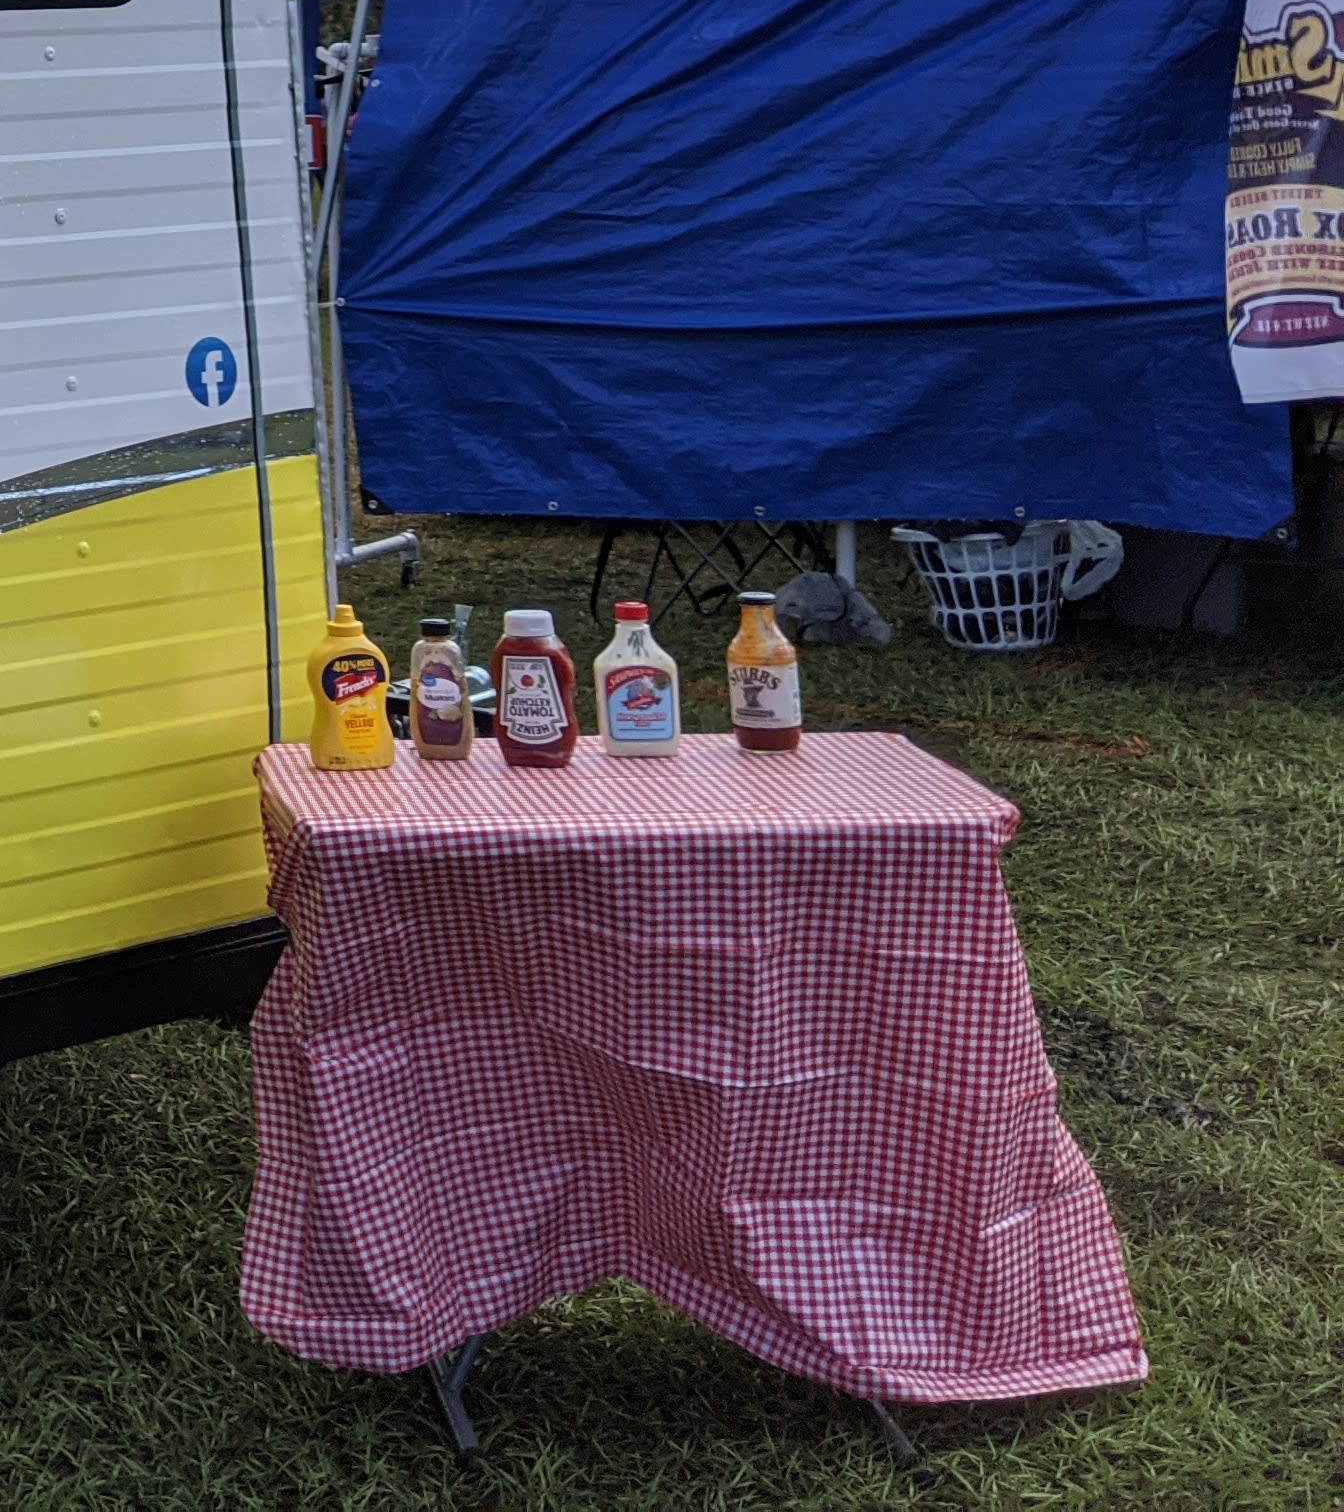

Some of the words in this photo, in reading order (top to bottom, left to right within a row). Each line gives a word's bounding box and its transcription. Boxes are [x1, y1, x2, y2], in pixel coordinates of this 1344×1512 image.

[510, 697, 551, 707] KETCHUP
[509, 706, 555, 717] TOMATO
[516, 723, 550, 735] HEINZ
